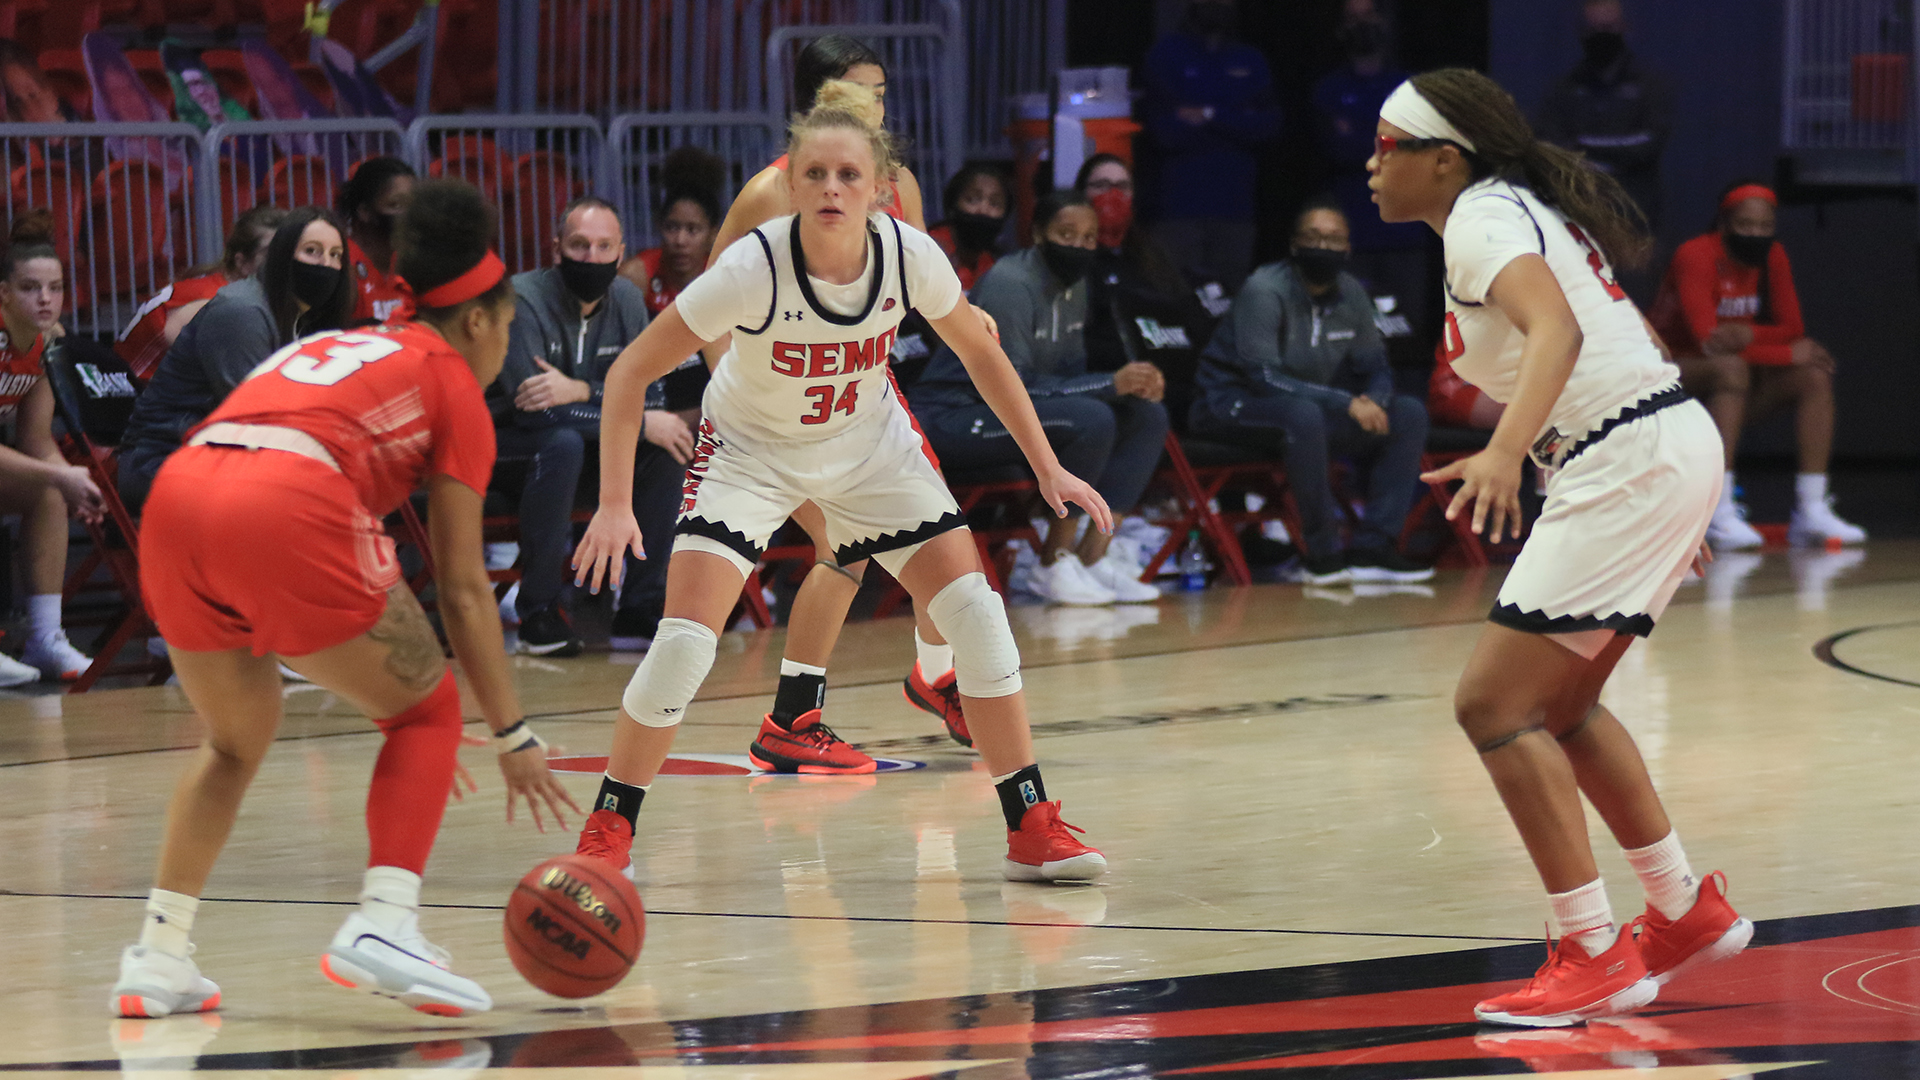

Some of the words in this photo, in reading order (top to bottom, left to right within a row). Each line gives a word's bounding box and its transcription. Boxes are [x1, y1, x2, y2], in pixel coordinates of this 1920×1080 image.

[771, 325, 897, 378] SEMO
[800, 379, 863, 425] 34
[540, 866, 623, 936] Wilson
[526, 906, 592, 961] NCAA
